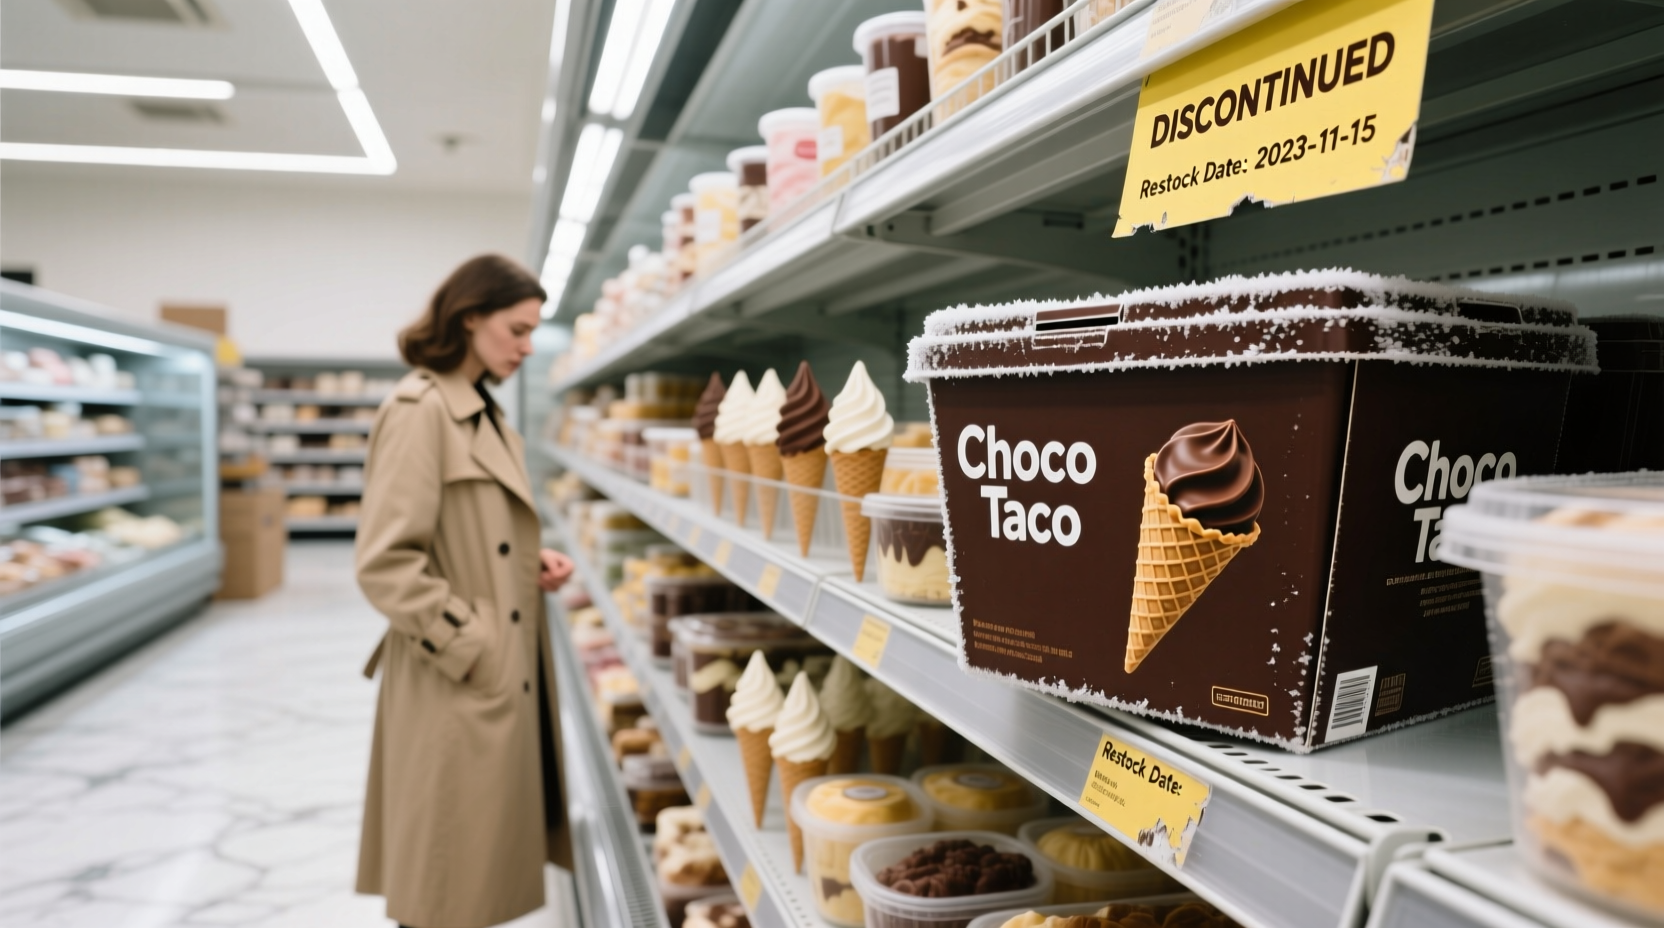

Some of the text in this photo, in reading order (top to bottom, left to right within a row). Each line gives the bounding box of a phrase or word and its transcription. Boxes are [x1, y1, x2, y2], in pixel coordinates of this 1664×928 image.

[1150, 31, 1396, 149] DISCONTINUED
[1139, 113, 1378, 199] Restock Date: 2023-11-15
[957, 424, 1097, 485] Choco
[980, 485, 1082, 547] Taco
[1101, 741, 1147, 779] Restock
[1148, 765, 1183, 796] Date:
